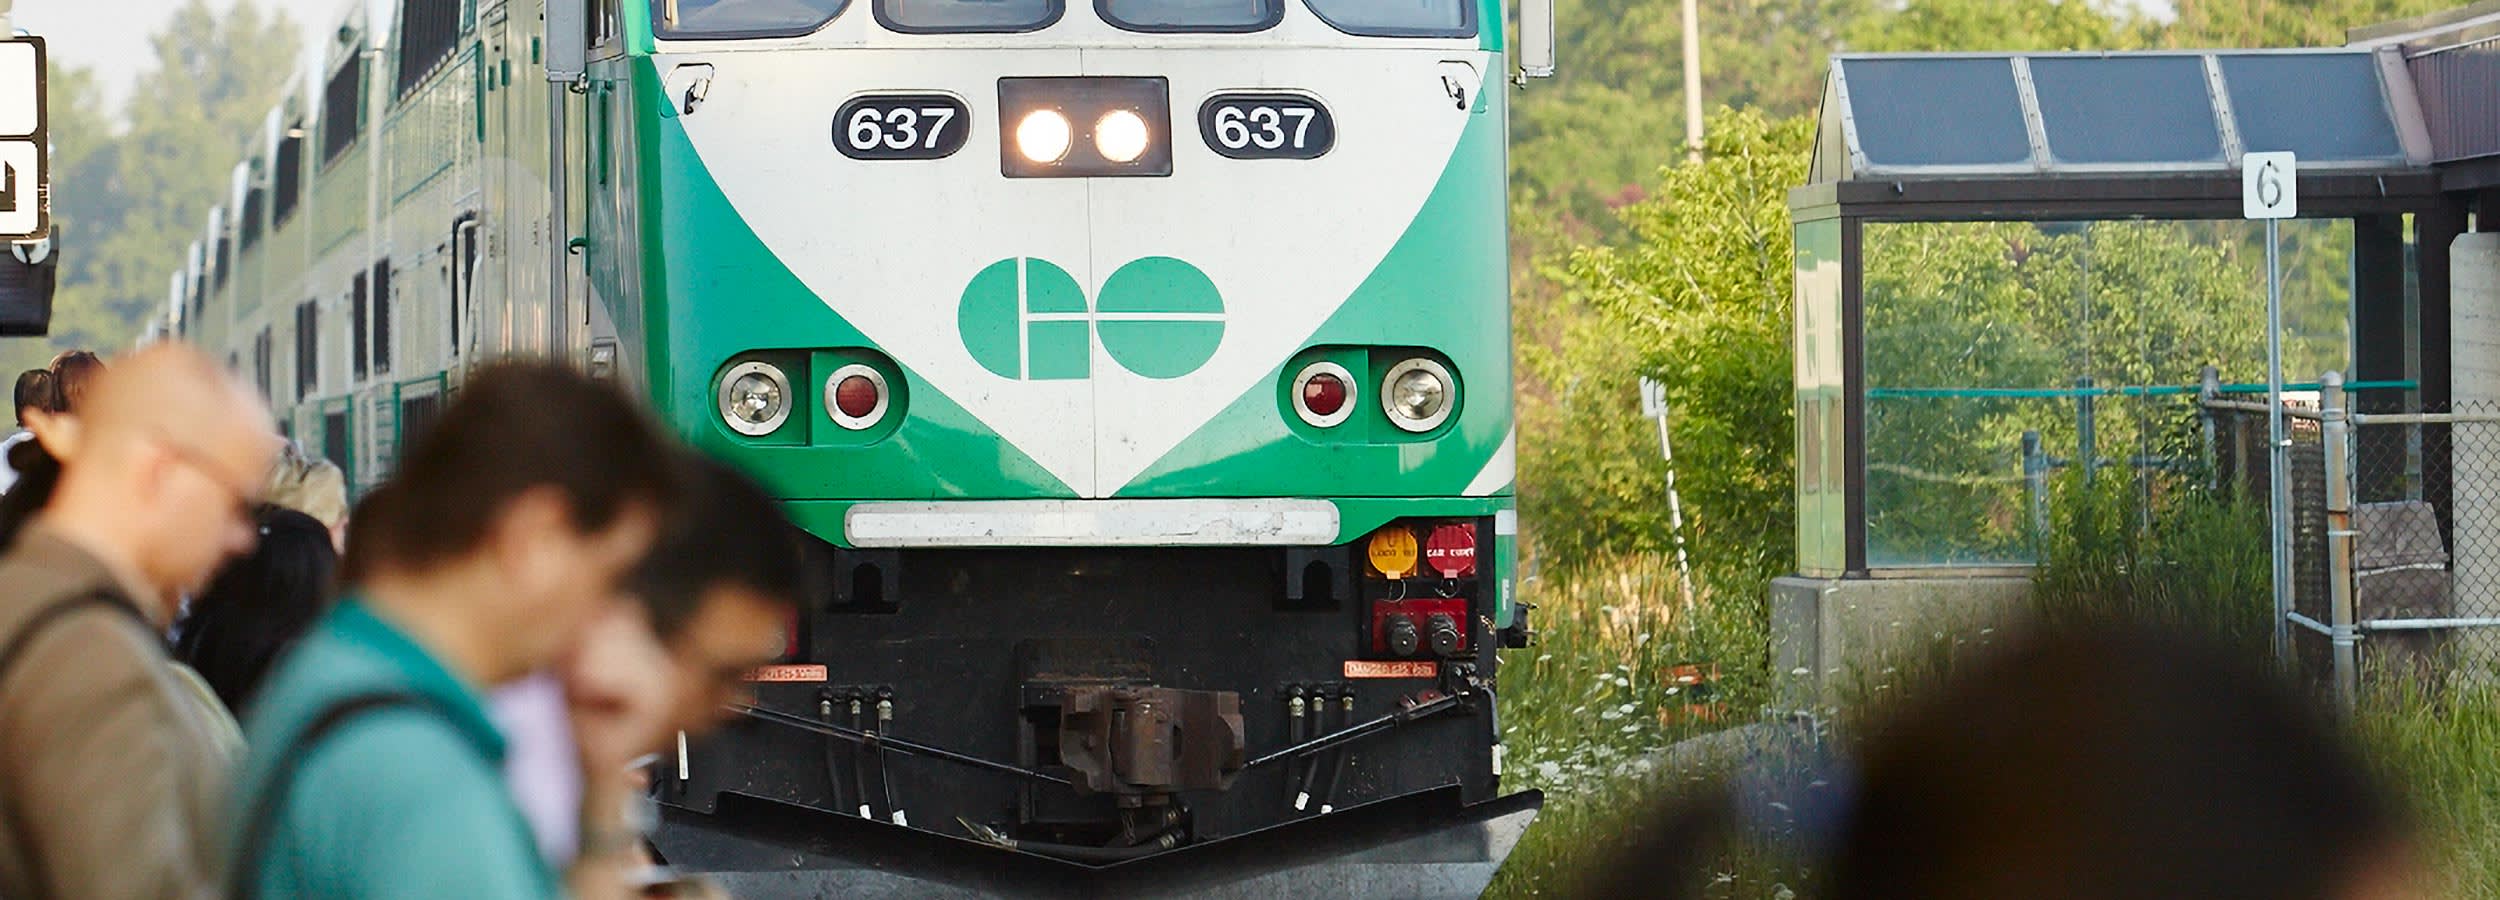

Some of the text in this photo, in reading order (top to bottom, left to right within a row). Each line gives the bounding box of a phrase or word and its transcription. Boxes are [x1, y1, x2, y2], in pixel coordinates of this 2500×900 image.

[848, 107, 955, 150] 637
[1215, 106, 1316, 149] 637
[2256, 160, 2282, 208] 6
[957, 255, 1225, 380] GO
[1426, 548, 1446, 558] CAR
